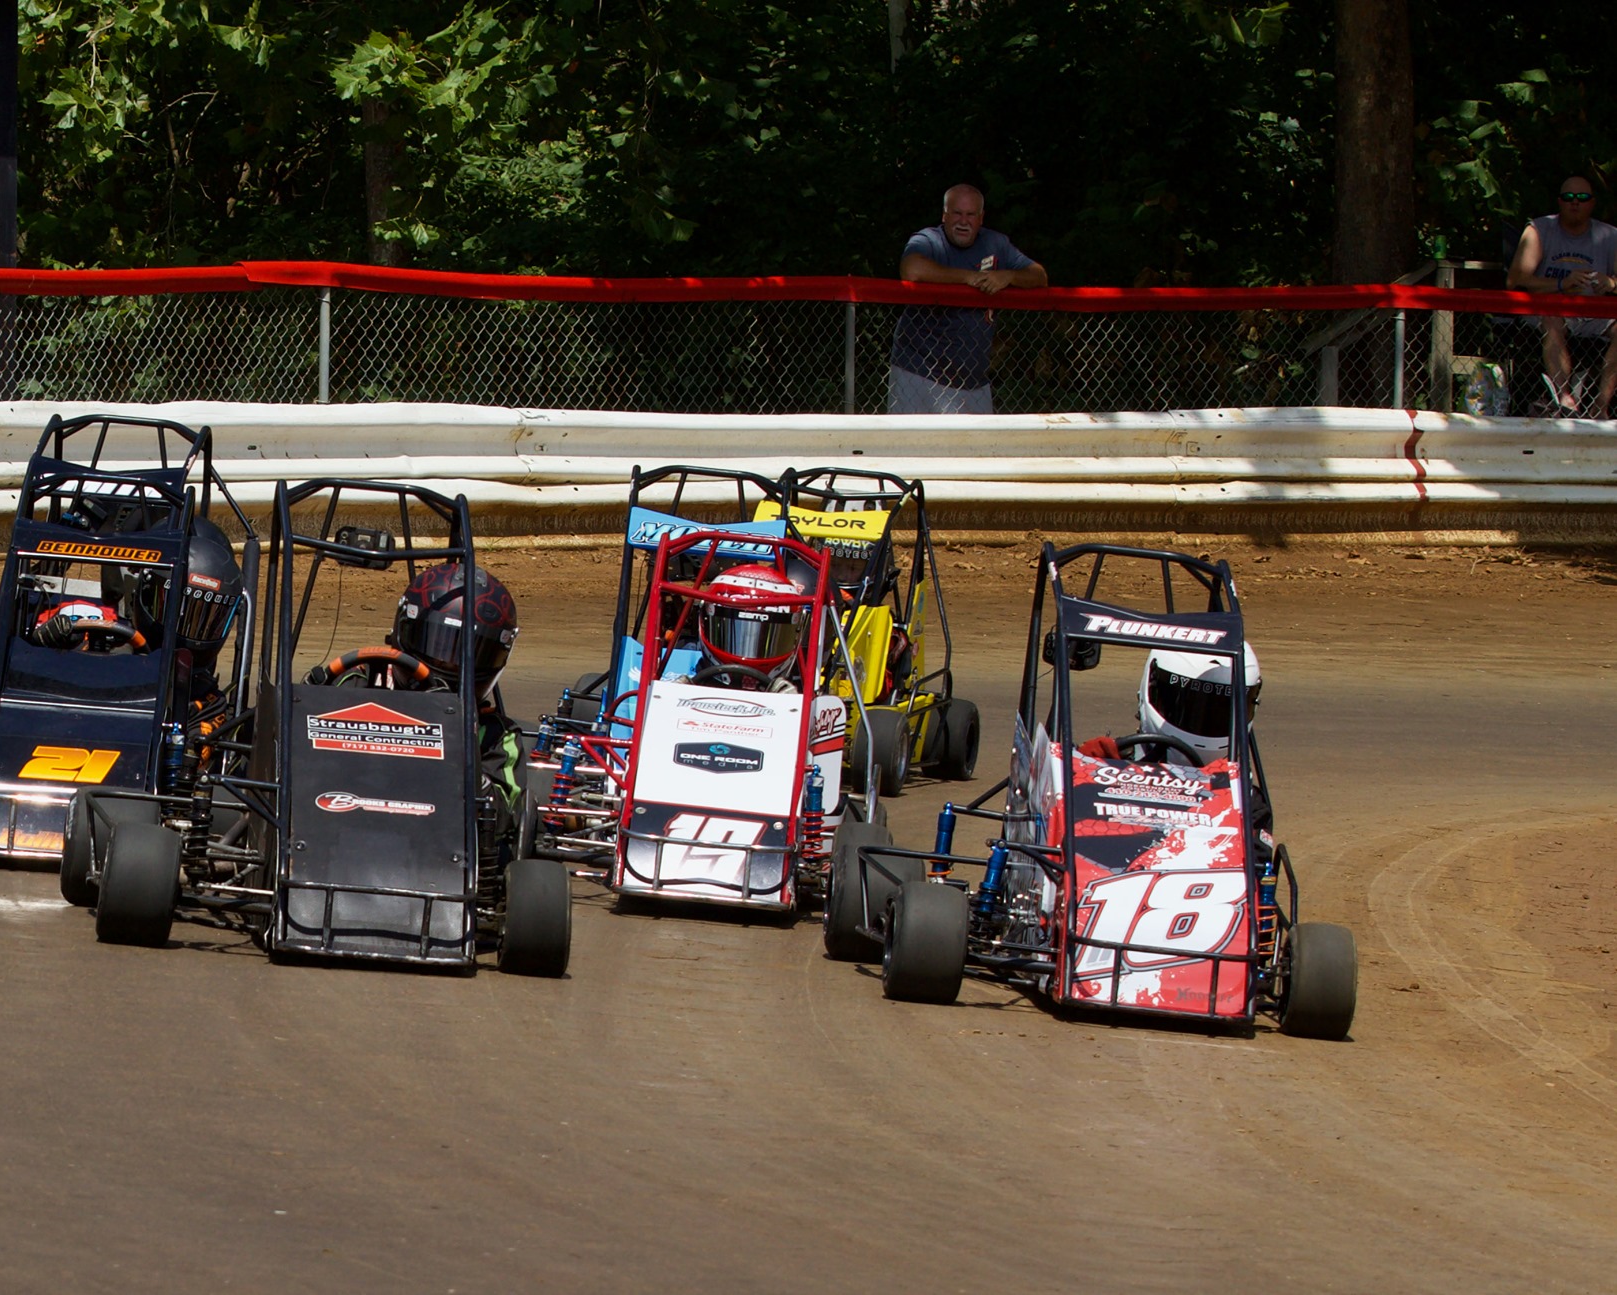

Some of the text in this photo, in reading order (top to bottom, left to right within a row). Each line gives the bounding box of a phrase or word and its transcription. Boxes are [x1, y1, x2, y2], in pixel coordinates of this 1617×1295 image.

[36, 540, 163, 563] BEINHOWER
[738, 611, 770, 622] zamp
[1080, 613, 1228, 645] PLUNKERT
[309, 718, 441, 736] Strausbaugh's
[309, 731, 443, 749] General Contracting
[342, 742, 368, 750] (717)
[18, 745, 121, 784] 21
[679, 753, 759, 765] ONE ROOM
[1094, 766, 1204, 795] Scentsy
[1093, 802, 1143, 817] TRUE
[1144, 807, 1213, 828] POWER
[1075, 870, 1248, 977] 18
